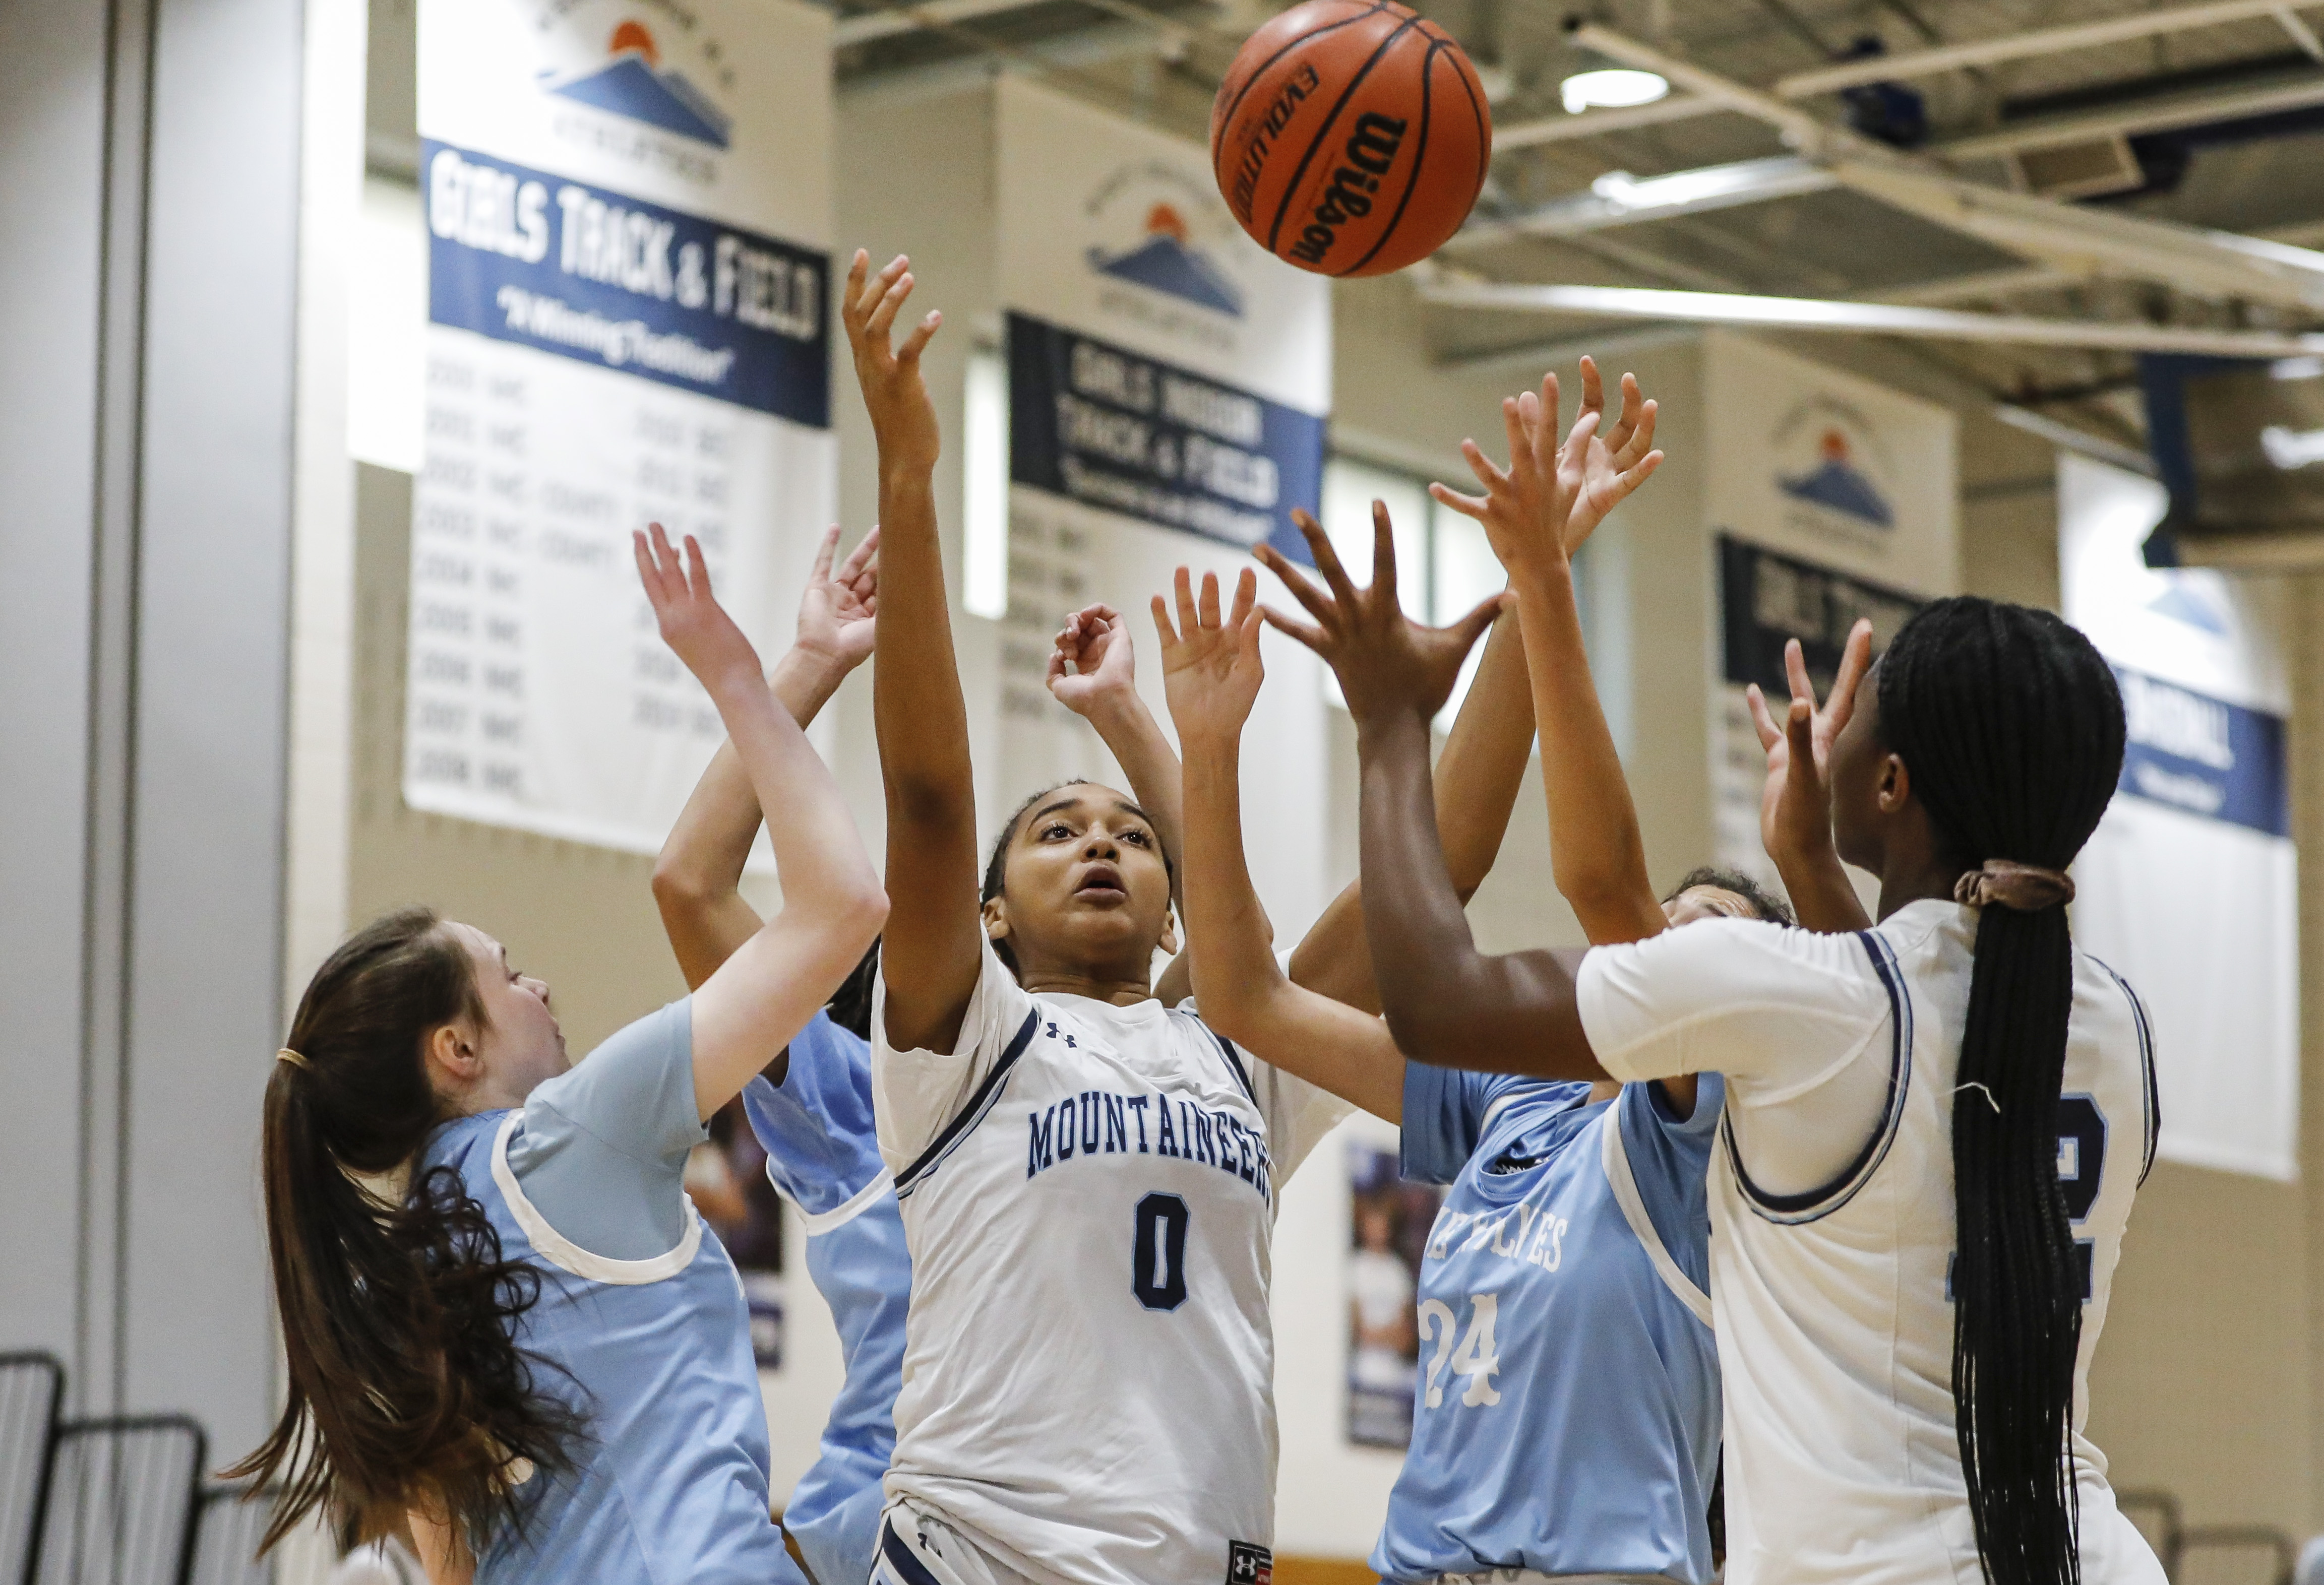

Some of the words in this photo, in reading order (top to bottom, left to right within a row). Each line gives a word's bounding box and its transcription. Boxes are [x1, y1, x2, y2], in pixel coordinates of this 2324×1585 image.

[430, 149, 549, 263] GIRLS
[557, 184, 676, 301] TRACK
[676, 242, 706, 308] &
[714, 234, 820, 342] FIELD
[1289, 111, 1407, 264] Wilson
[1131, 1190, 1190, 1313] 0
[1418, 1293, 1501, 1409] 24
